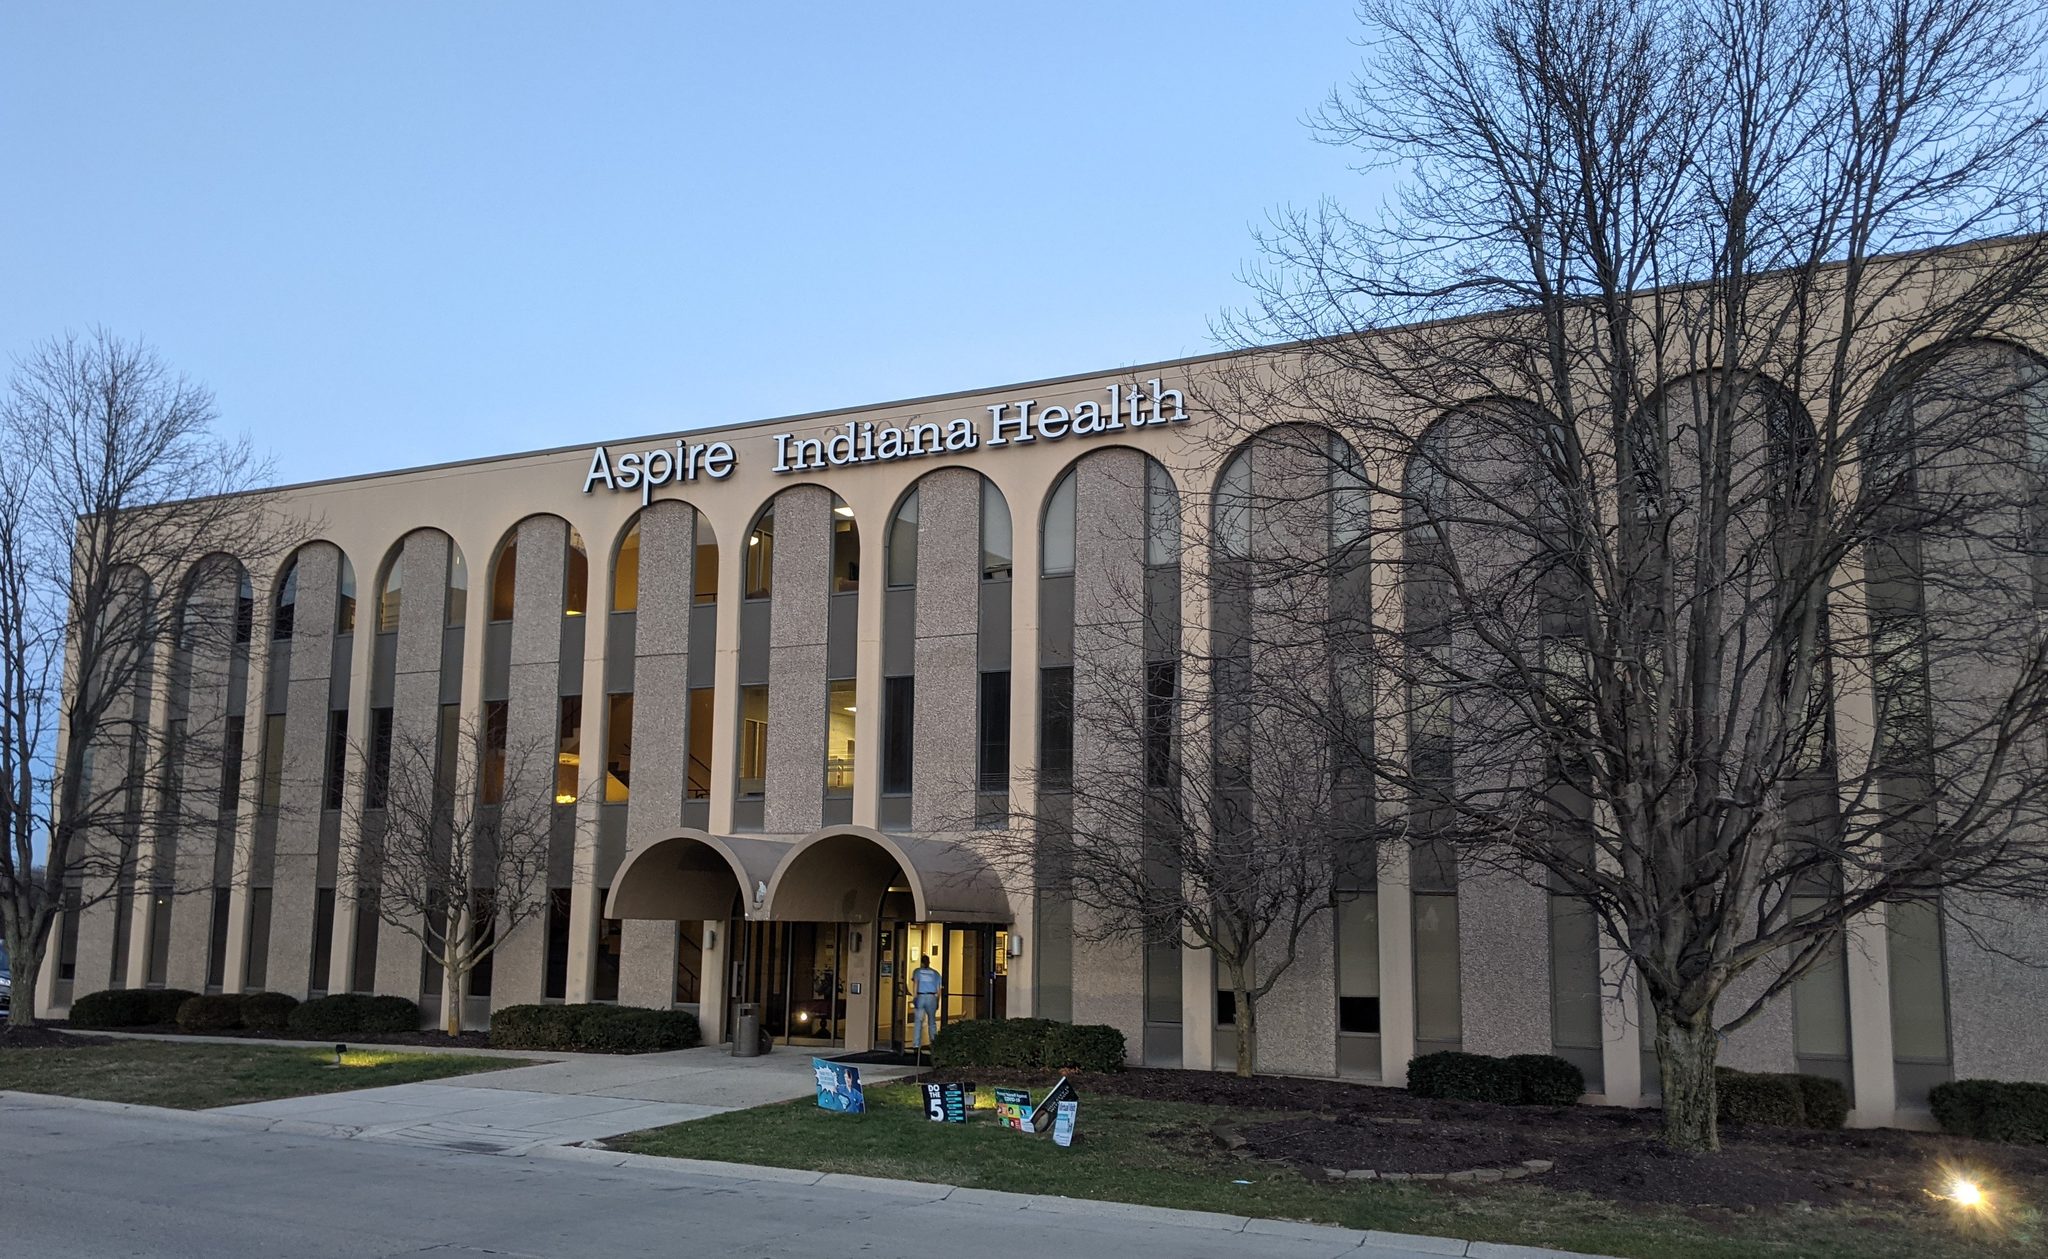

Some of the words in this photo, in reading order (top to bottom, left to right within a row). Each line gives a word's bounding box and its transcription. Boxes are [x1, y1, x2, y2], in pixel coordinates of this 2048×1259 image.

[582, 438, 735, 507] Aspire
[773, 416, 980, 474] Indiana
[987, 377, 1190, 447] Health
[928, 1084, 940, 1092] DO
[930, 1099, 944, 1122] 5
